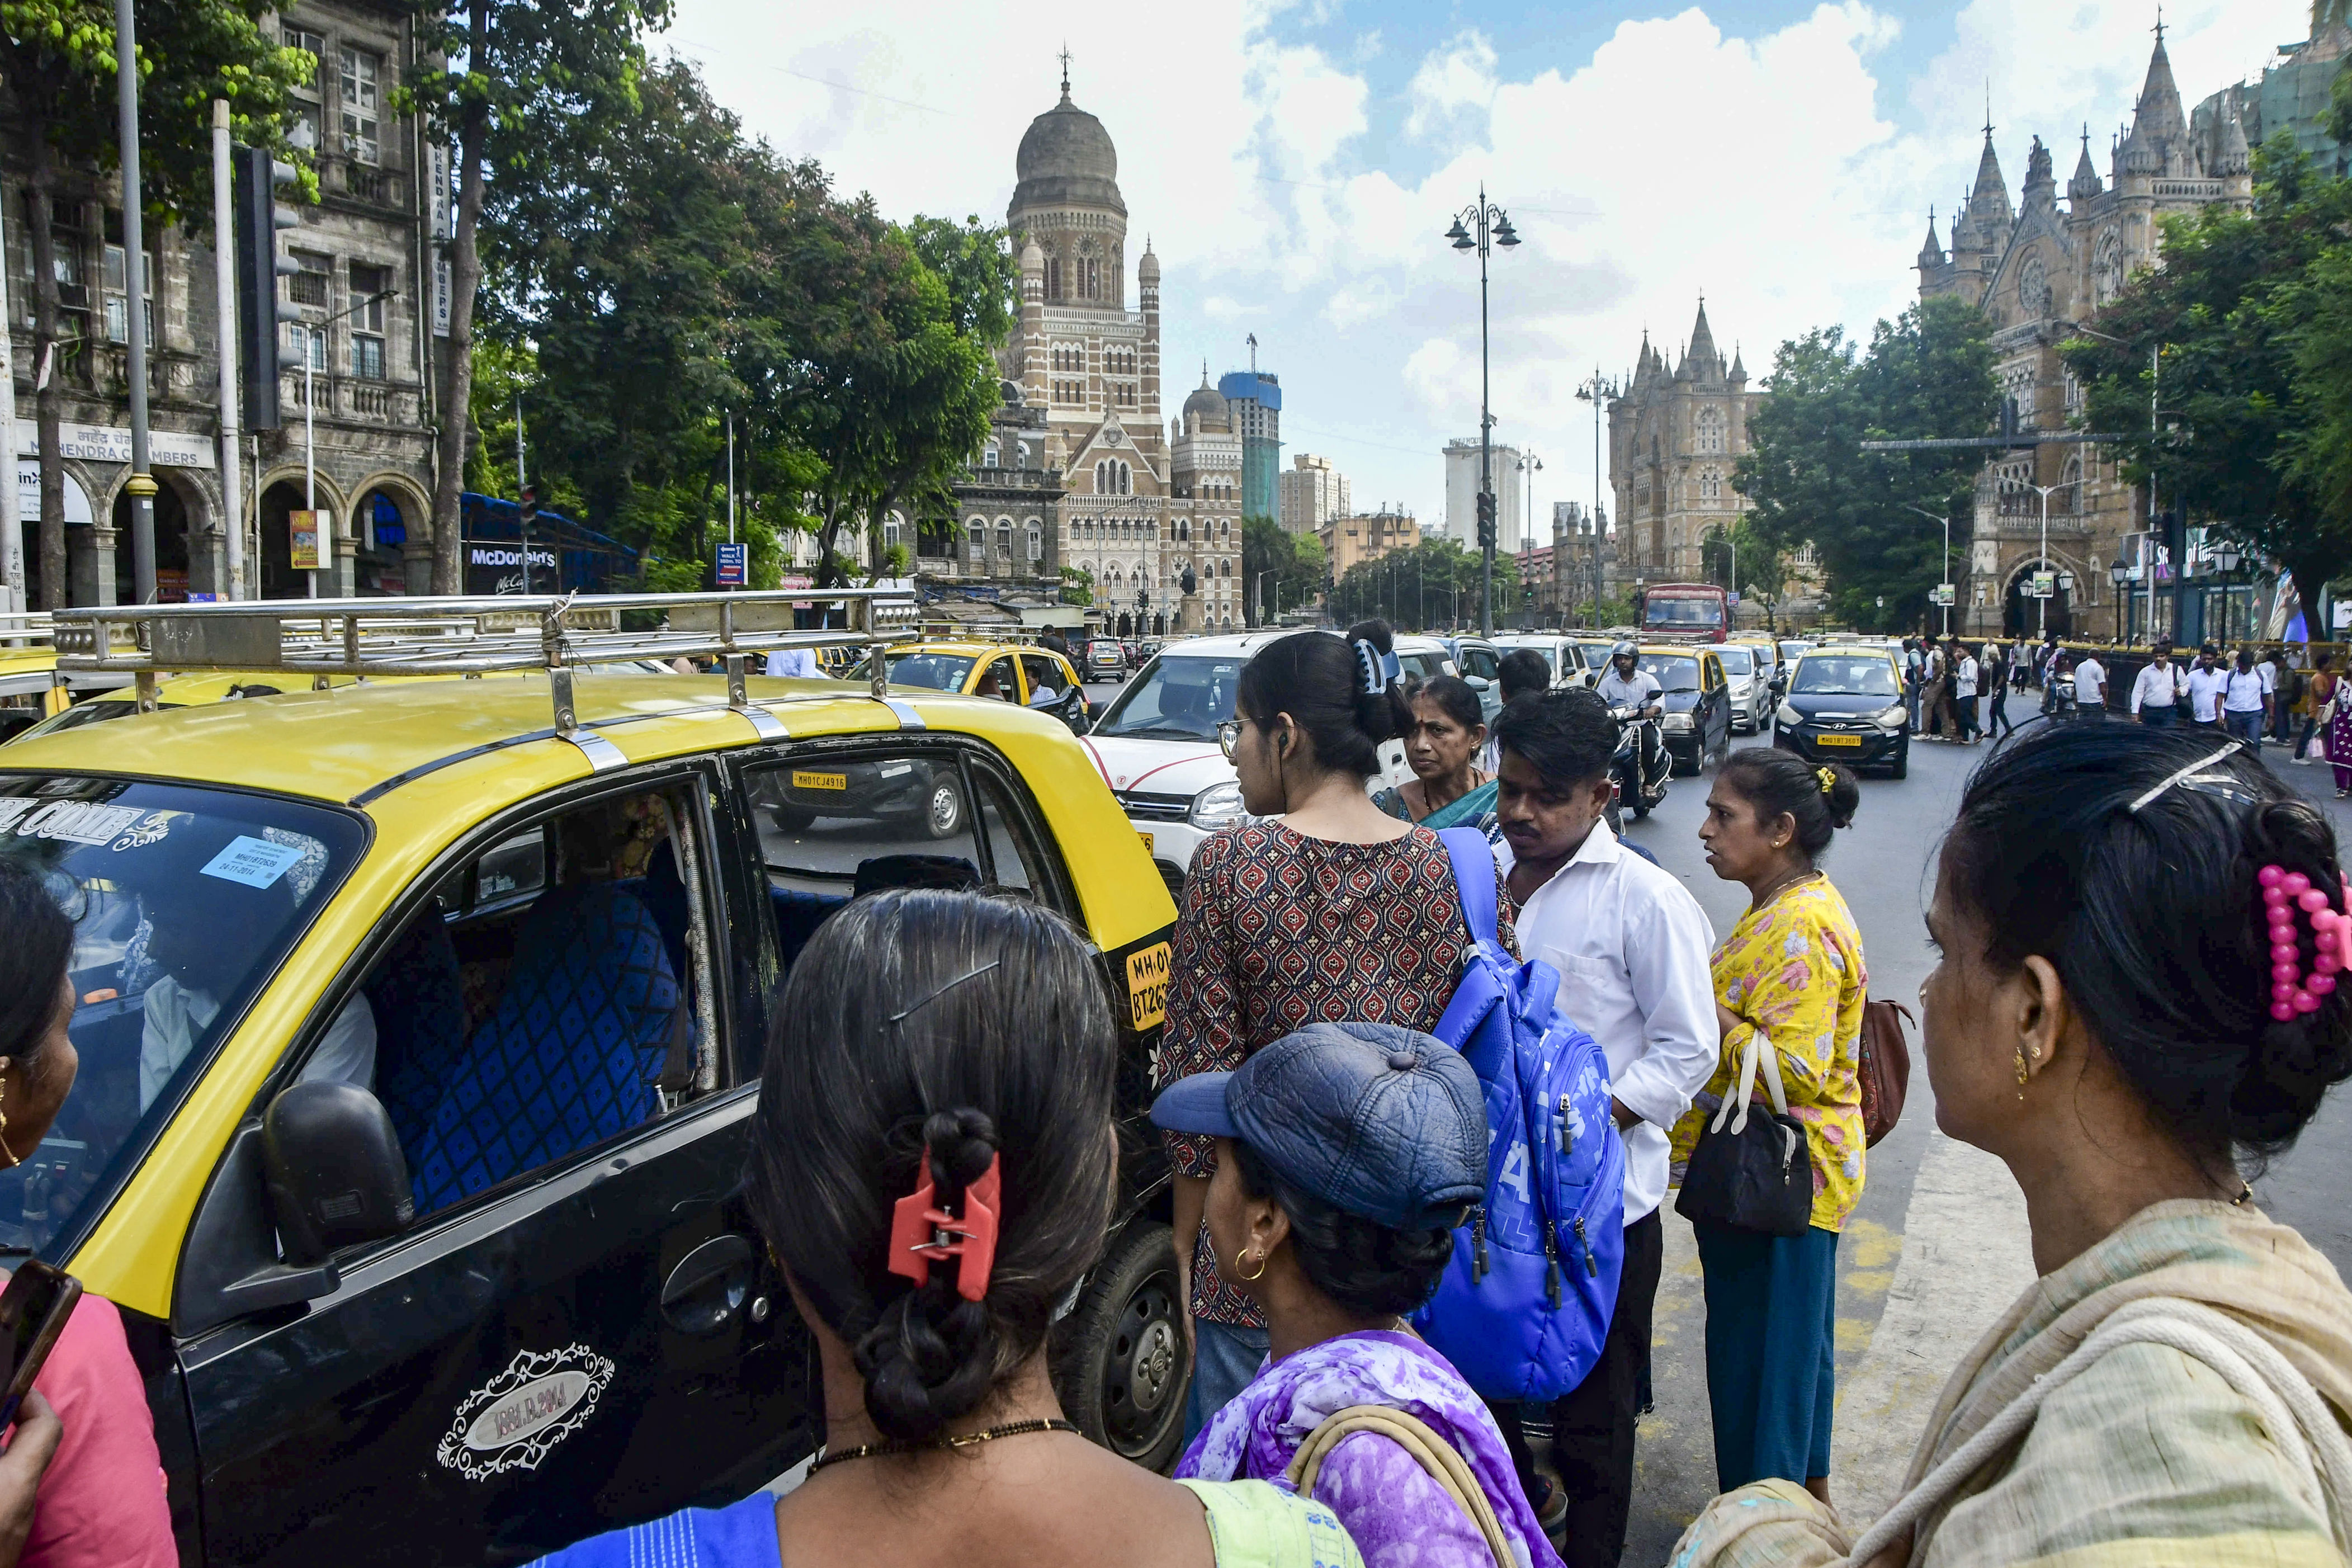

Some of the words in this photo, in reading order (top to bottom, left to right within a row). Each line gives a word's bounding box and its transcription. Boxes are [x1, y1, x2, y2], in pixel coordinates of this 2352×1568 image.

[434, 144, 444, 220] HENDRA
[437, 228, 447, 319] CMBERS
[30, 441, 117, 459] MHENDRA
[121, 448, 197, 465] CMBERS
[472, 549, 555, 567] McDonald's
[799, 775, 844, 787] MH01CJ4916
[235, 853, 277, 867] MH01BT2639
[219, 863, 256, 876] 24-11-2014
